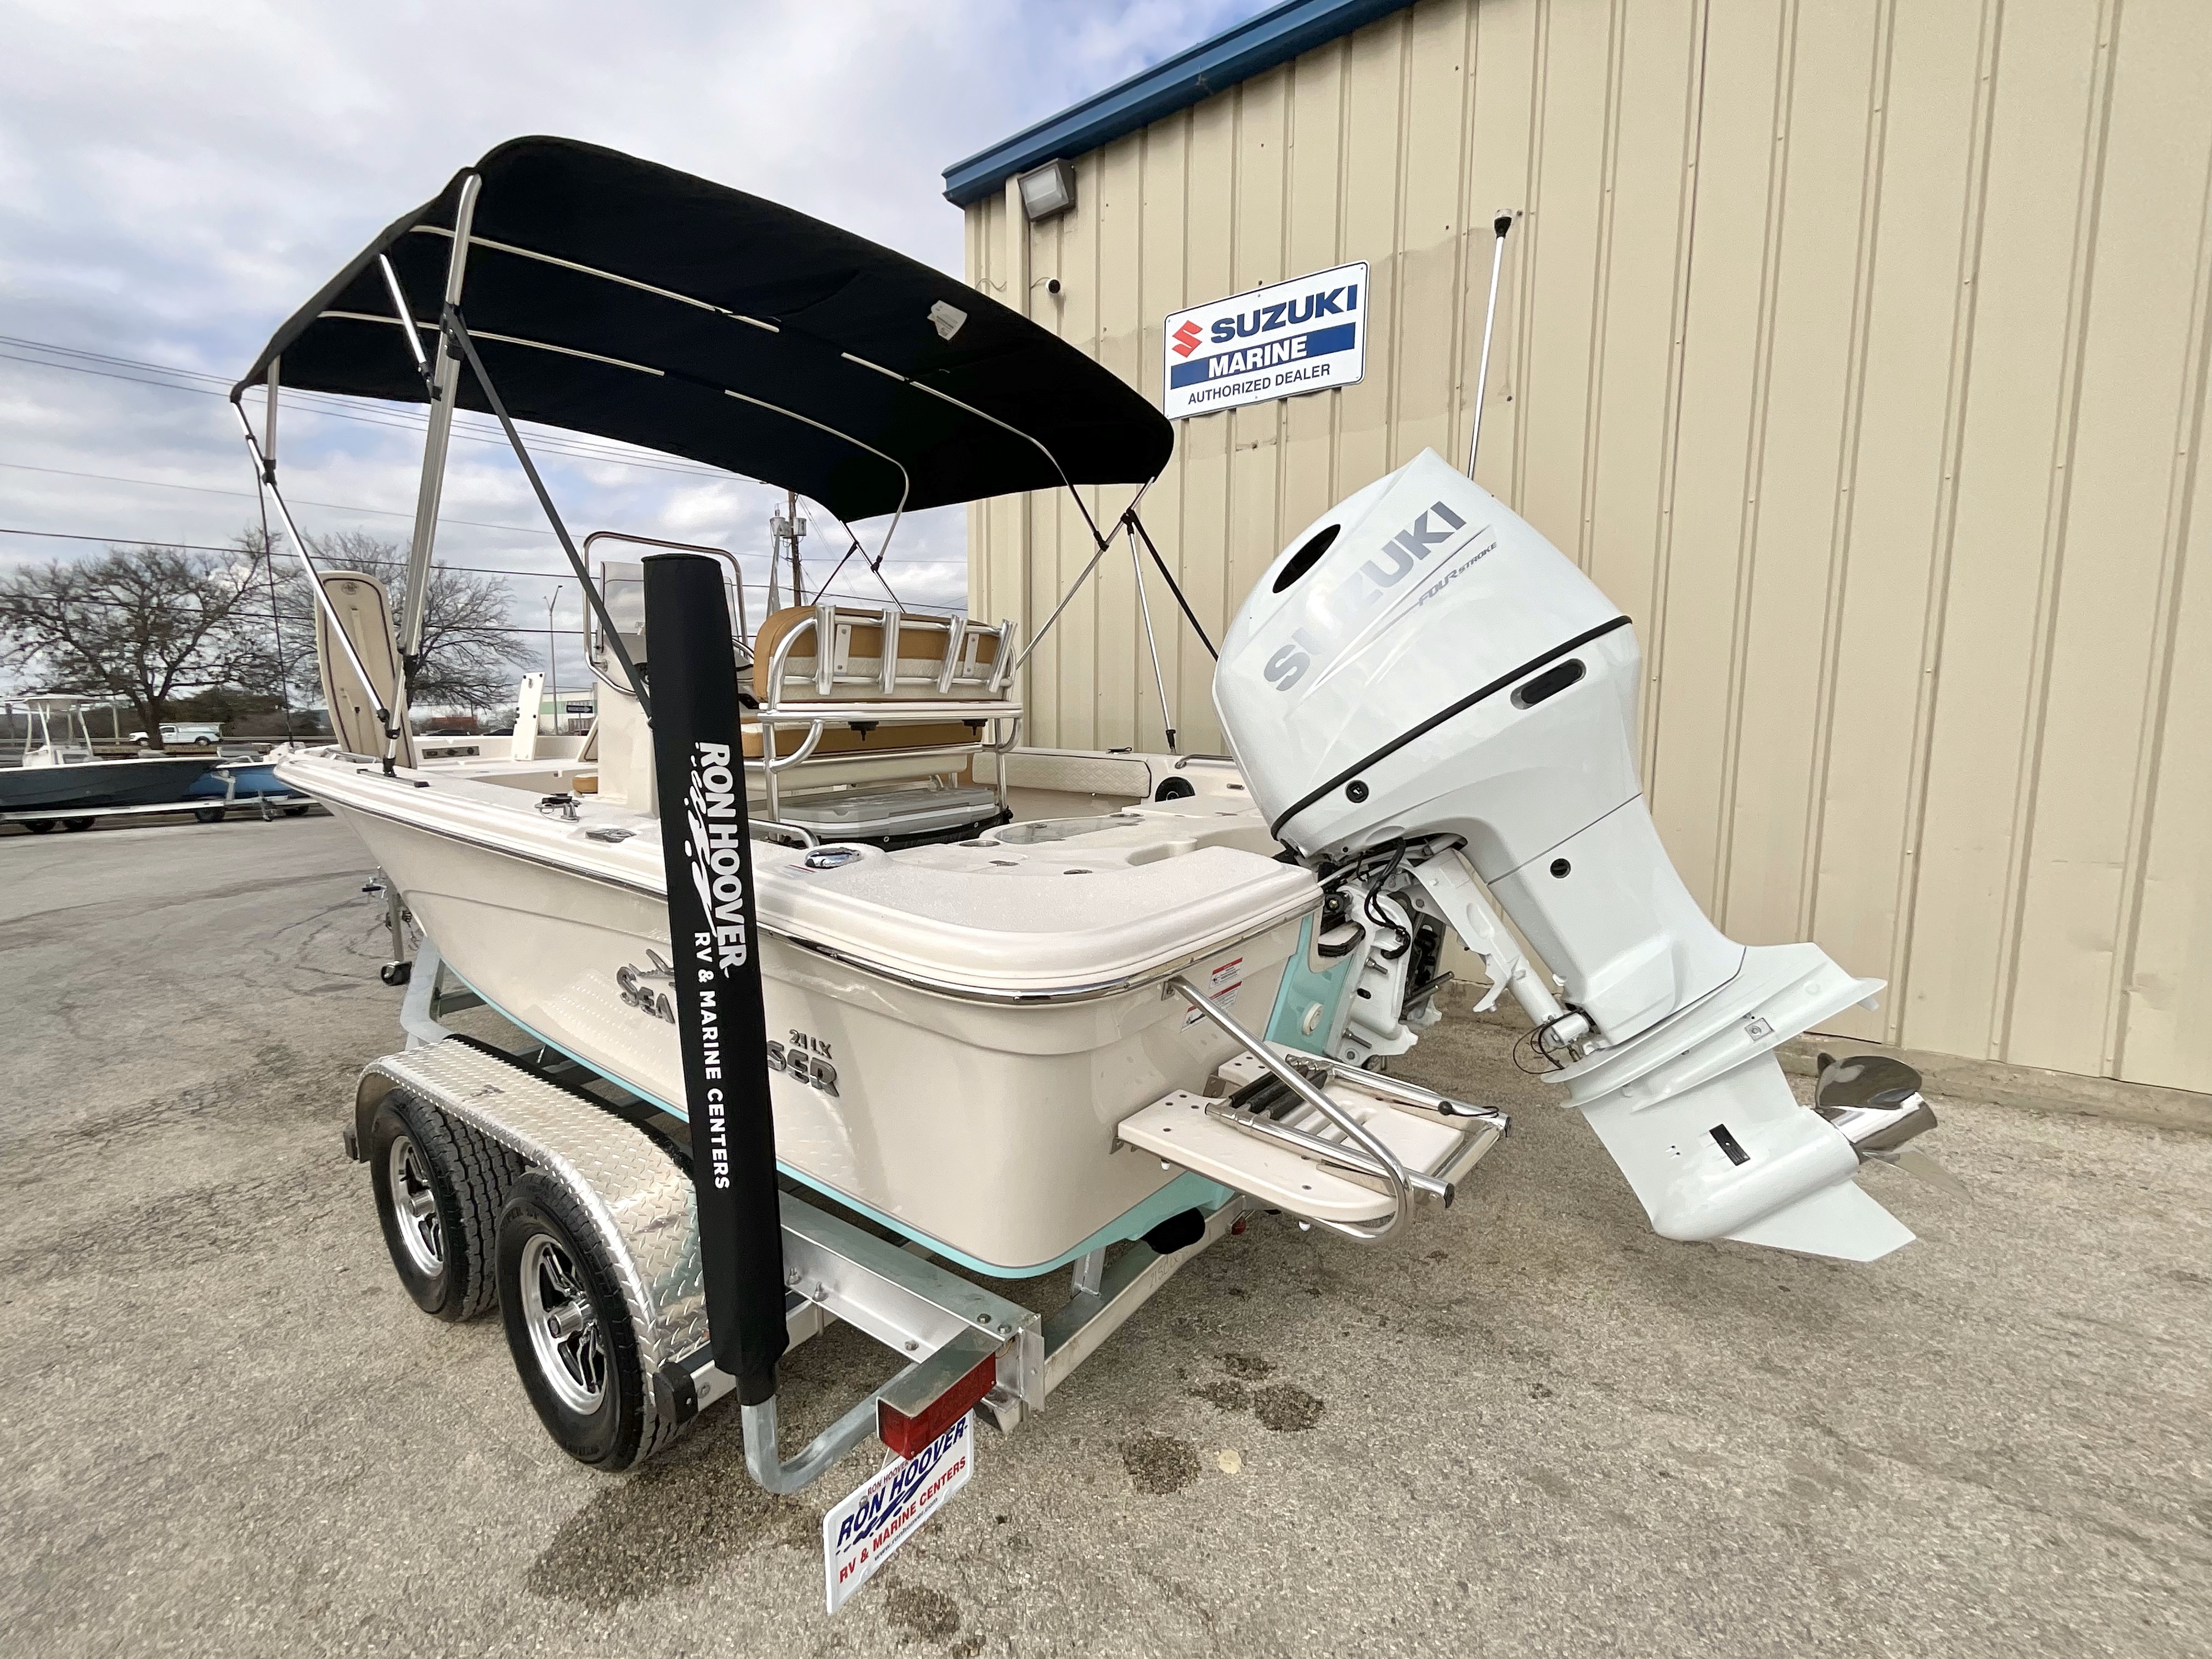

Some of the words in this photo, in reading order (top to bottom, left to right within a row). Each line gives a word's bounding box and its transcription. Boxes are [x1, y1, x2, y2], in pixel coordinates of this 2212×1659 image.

[1211, 284, 1358, 343] SUZUKI
[1188, 376, 1271, 405] AUTHORIZED
[1276, 363, 1330, 386] DEALER
[1208, 335, 1308, 379] MARINE
[1459, 541, 1497, 574] STROKE
[699, 742, 736, 817] RON
[709, 823, 747, 970] HOOVER
[695, 932, 713, 963] RV
[698, 969, 714, 983] &
[617, 966, 676, 1024] SEA
[699, 991, 721, 1080] MARINE
[789, 1029, 808, 1049] 21
[810, 1037, 831, 1059] LX
[767, 1040, 839, 1097] SER
[707, 1088, 730, 1189] CENTERS
[837, 1486, 886, 1548] RON
[889, 1417, 966, 1502] HOOVER
[867, 1480, 882, 1496] RON
[839, 1557, 856, 1584] RV
[860, 1548, 870, 1564] &
[873, 1500, 917, 1552] MARINE
[919, 1456, 966, 1506] CENTERS
[874, 1497, 938, 1561] www.ronhoover.com
